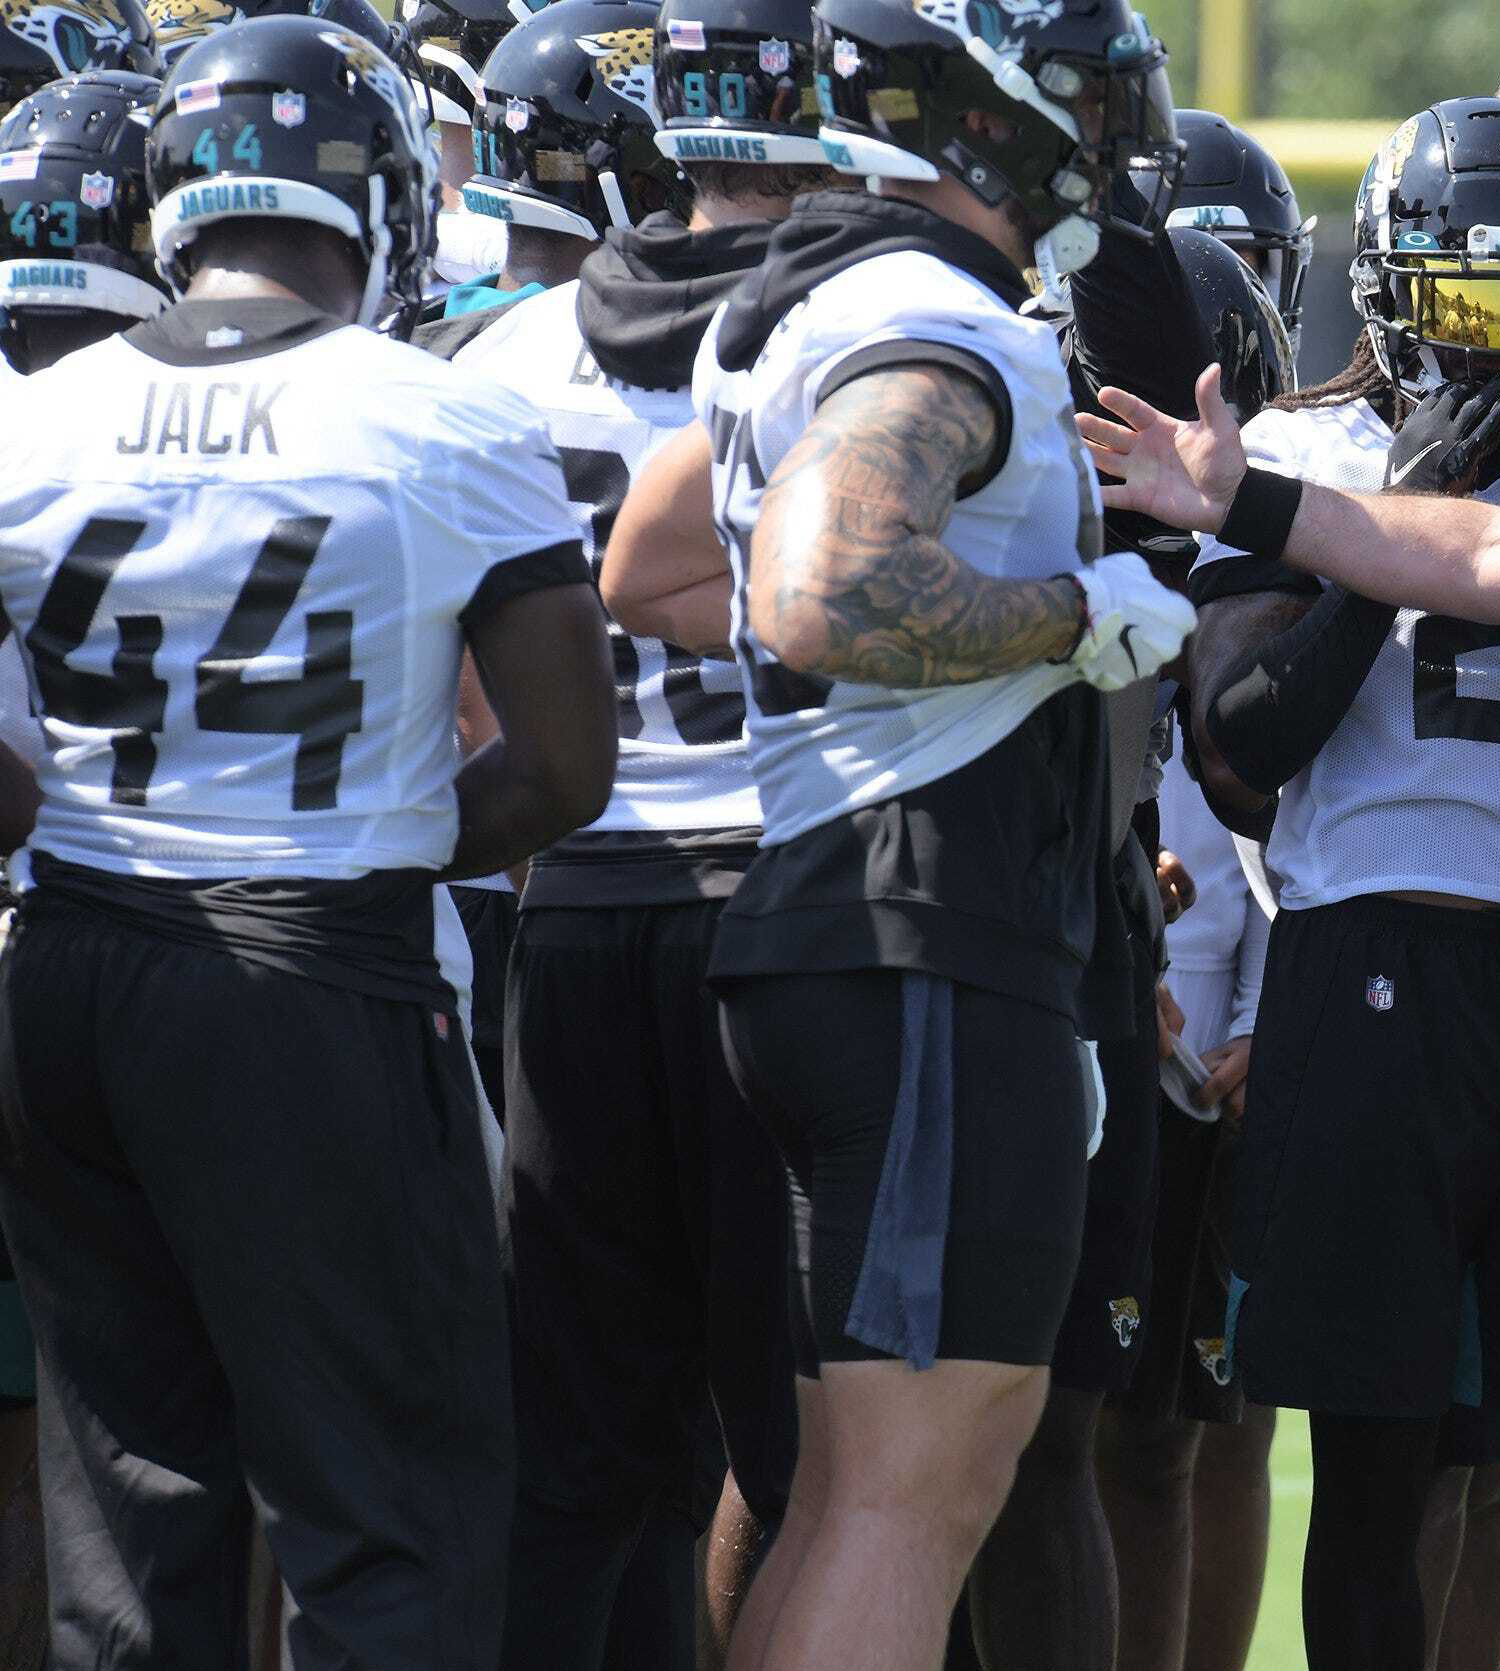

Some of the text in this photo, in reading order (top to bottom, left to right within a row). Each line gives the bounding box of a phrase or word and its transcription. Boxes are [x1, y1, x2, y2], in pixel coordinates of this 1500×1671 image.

[684, 72, 746, 118] 90
[193, 124, 262, 175] 44
[675, 135, 767, 161] JAGUARS
[177, 184, 280, 221] JAGUARS
[1193, 207, 1225, 226] JAX
[10, 201, 78, 248] 43
[8, 264, 88, 290] JAGUARS
[117, 381, 287, 456] JACK
[25, 516, 363, 811] 44
[1368, 991, 1392, 1006] NFL
